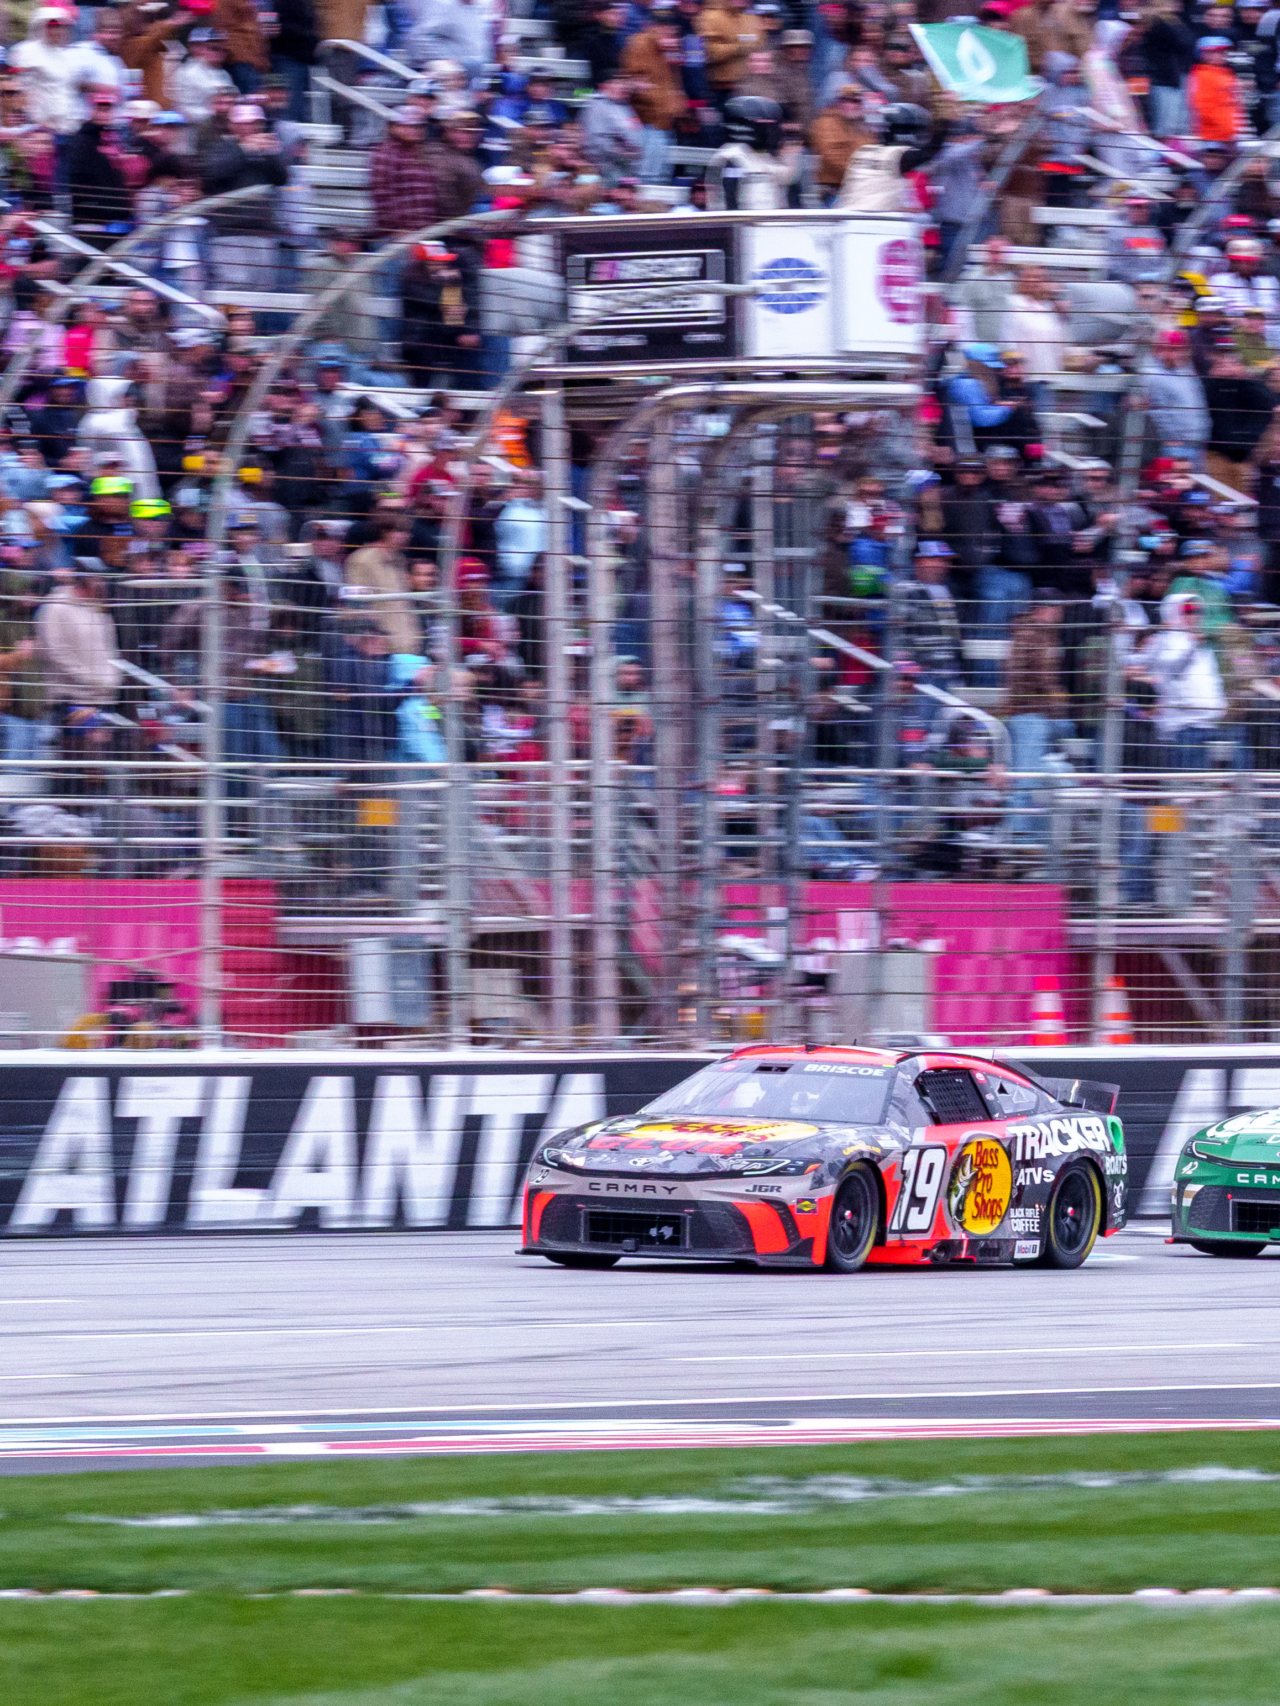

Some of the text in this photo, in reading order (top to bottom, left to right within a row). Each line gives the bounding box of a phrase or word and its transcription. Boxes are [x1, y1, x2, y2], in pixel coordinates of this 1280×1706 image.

[803, 1064, 886, 1077] BRISCOE
[1006, 1117, 1111, 1161] TRACKER
[974, 1141, 999, 1167] Bass
[1105, 1155, 1127, 1175] BOATS
[1181, 1162, 1199, 1175] 42
[974, 1168, 993, 1192] Pro
[1016, 1167, 1055, 1186] ATVs
[589, 1182, 678, 1195] CAMRY
[745, 1185, 782, 1193] JGR
[891, 1147, 946, 1231] 19
[972, 1193, 1003, 1224] Shops
[1011, 1219, 1040, 1232] COFFEE
